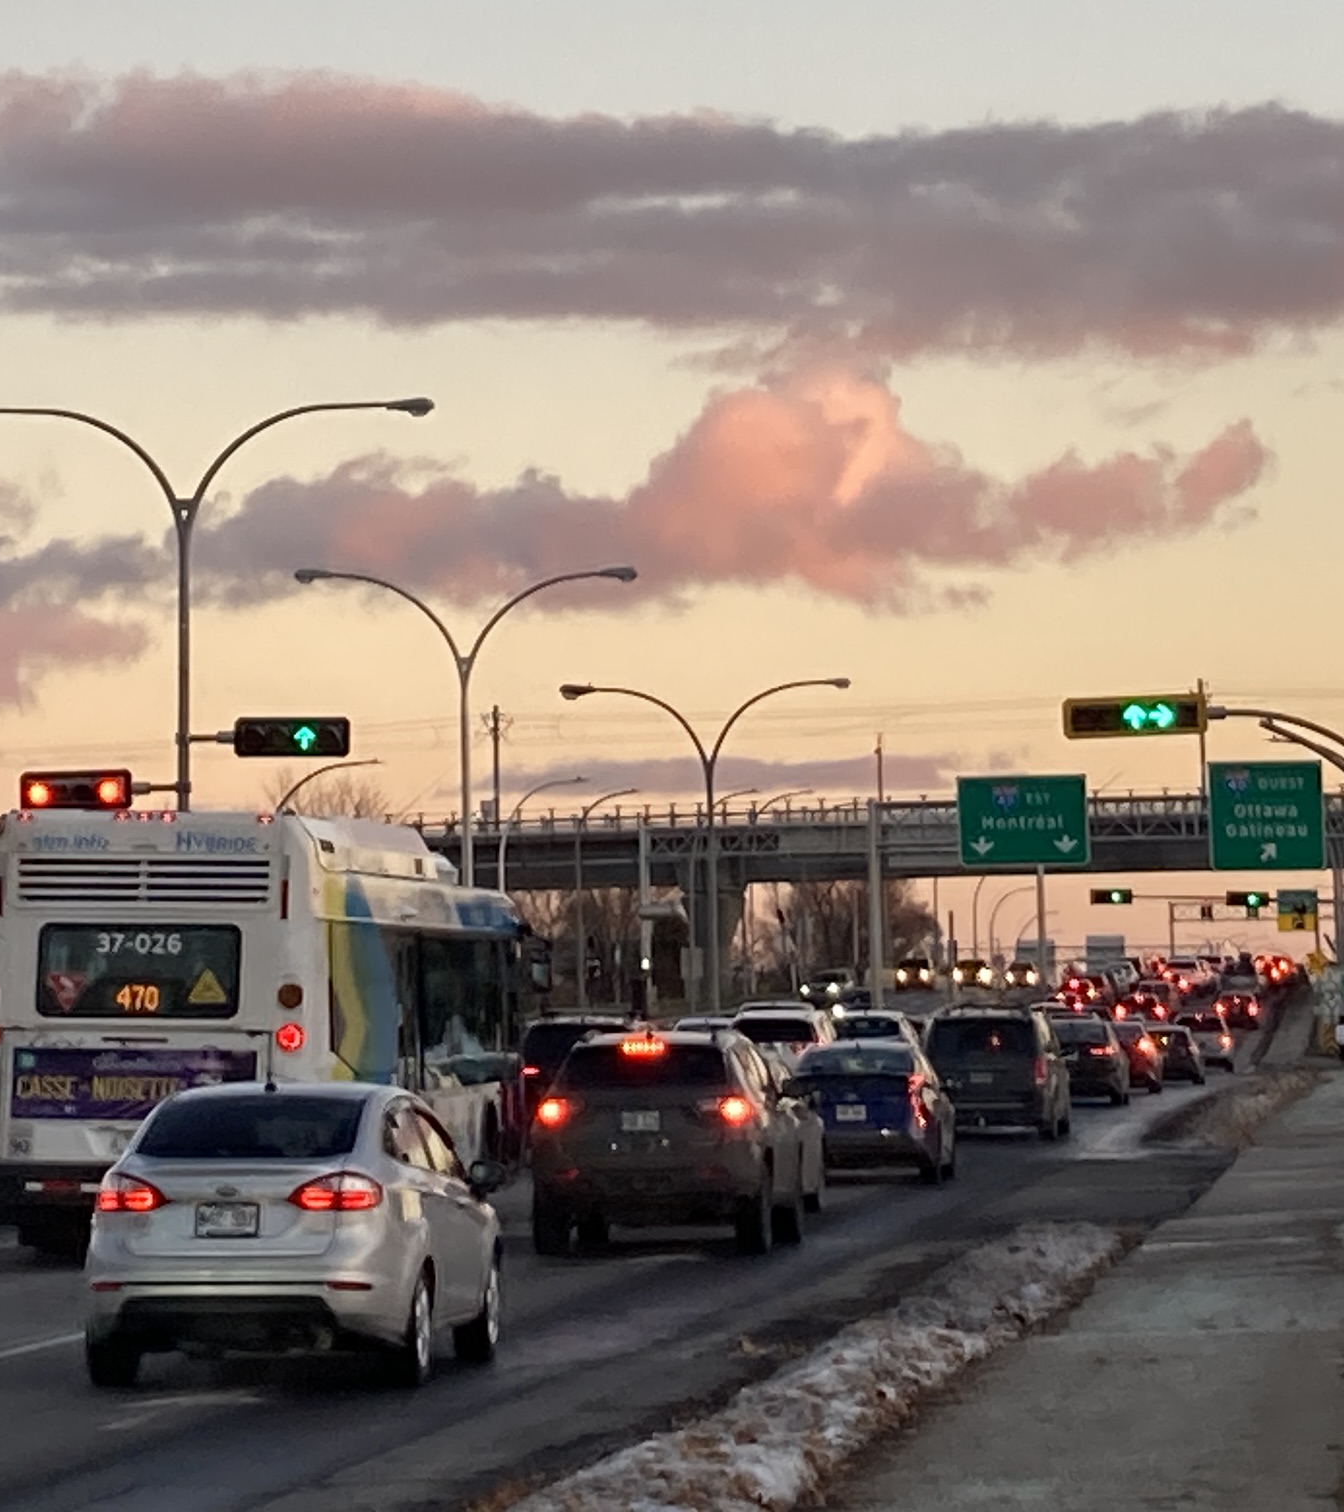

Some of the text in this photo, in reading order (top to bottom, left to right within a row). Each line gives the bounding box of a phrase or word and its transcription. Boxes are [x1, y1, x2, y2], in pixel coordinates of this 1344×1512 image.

[1257, 777, 1304, 790] OUEST
[1234, 803, 1298, 818] Ottawa
[981, 814, 1064, 830] Montréal
[1225, 822, 1308, 838] Gatineau
[96, 933, 182, 955] 37-026
[115, 984, 160, 1011] 470
